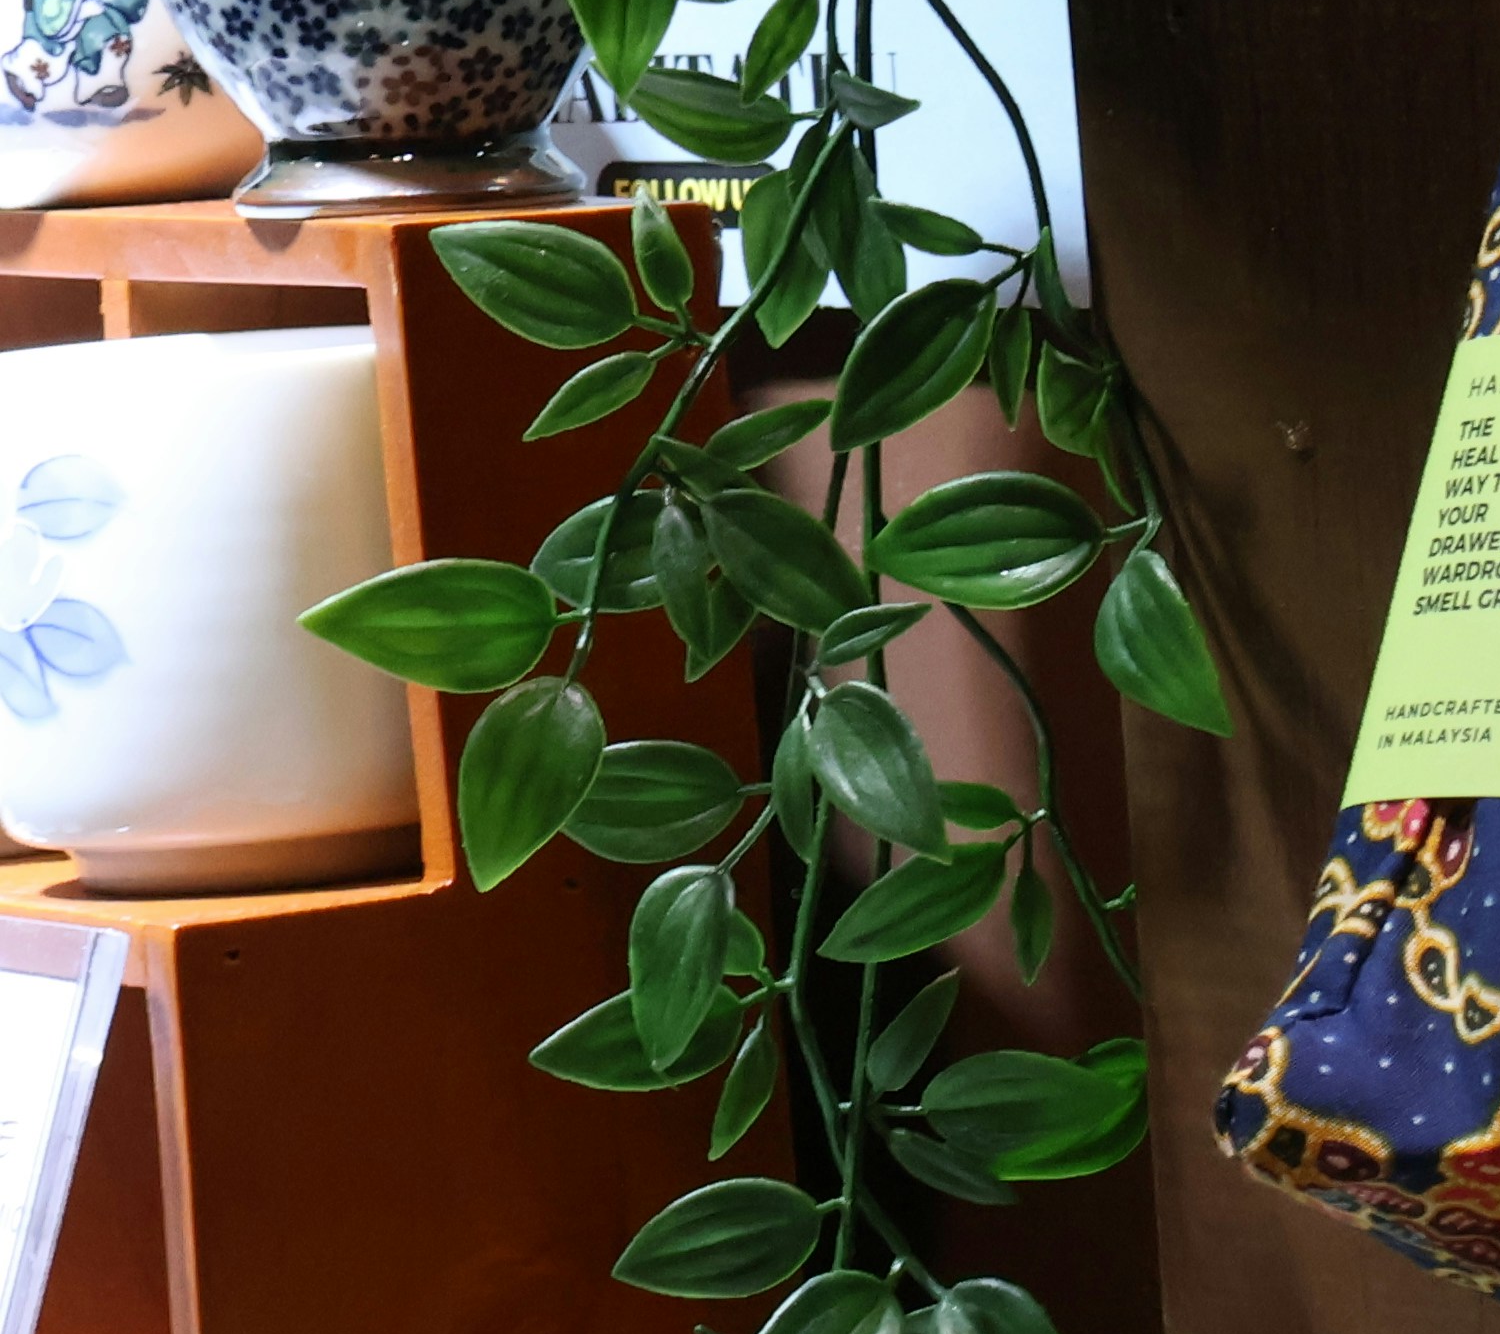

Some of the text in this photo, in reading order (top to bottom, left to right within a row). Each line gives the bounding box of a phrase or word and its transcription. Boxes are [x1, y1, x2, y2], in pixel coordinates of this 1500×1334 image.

[1459, 417, 1495, 441] THE
[1444, 474, 1489, 499] WAY
[1438, 503, 1488, 528] YOUR
[1412, 590, 1472, 617] SMELL
[1377, 727, 1492, 750] IN MALAYSIA
